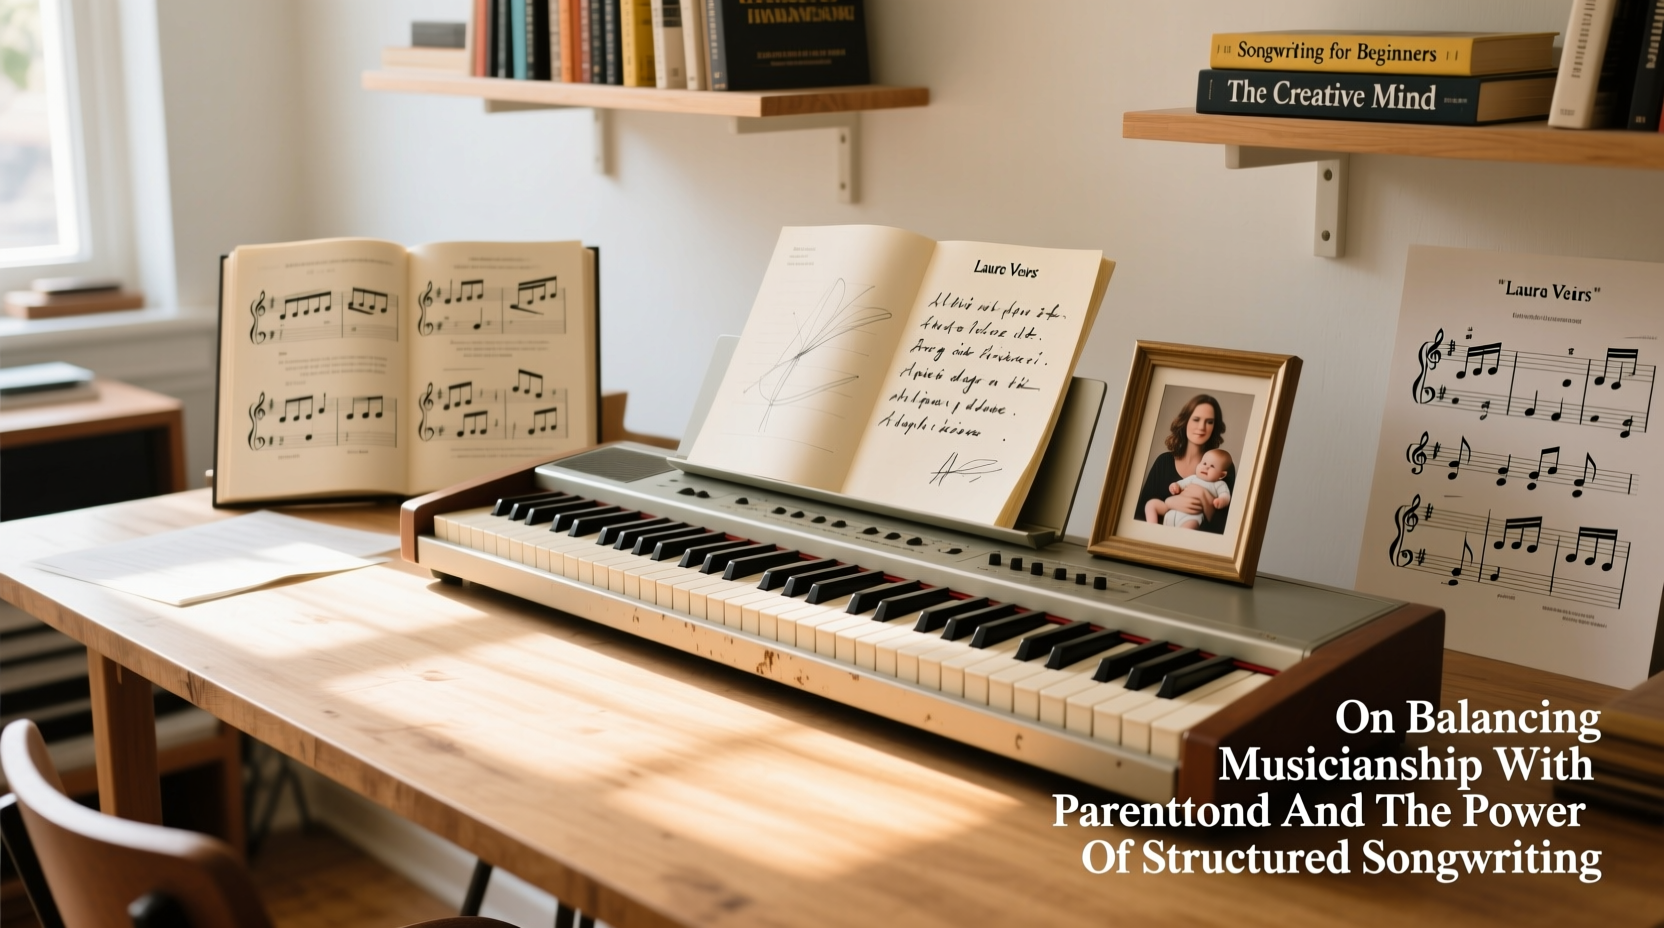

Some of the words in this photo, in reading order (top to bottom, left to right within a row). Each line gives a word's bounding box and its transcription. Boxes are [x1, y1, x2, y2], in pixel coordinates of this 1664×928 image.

[1237, 40, 1325, 65] Songwriting
[1329, 41, 1352, 60] for
[1357, 42, 1437, 67] Beginners
[1227, 79, 1267, 104] The
[1273, 80, 1365, 108] Creative
[1371, 83, 1436, 110] Mind
